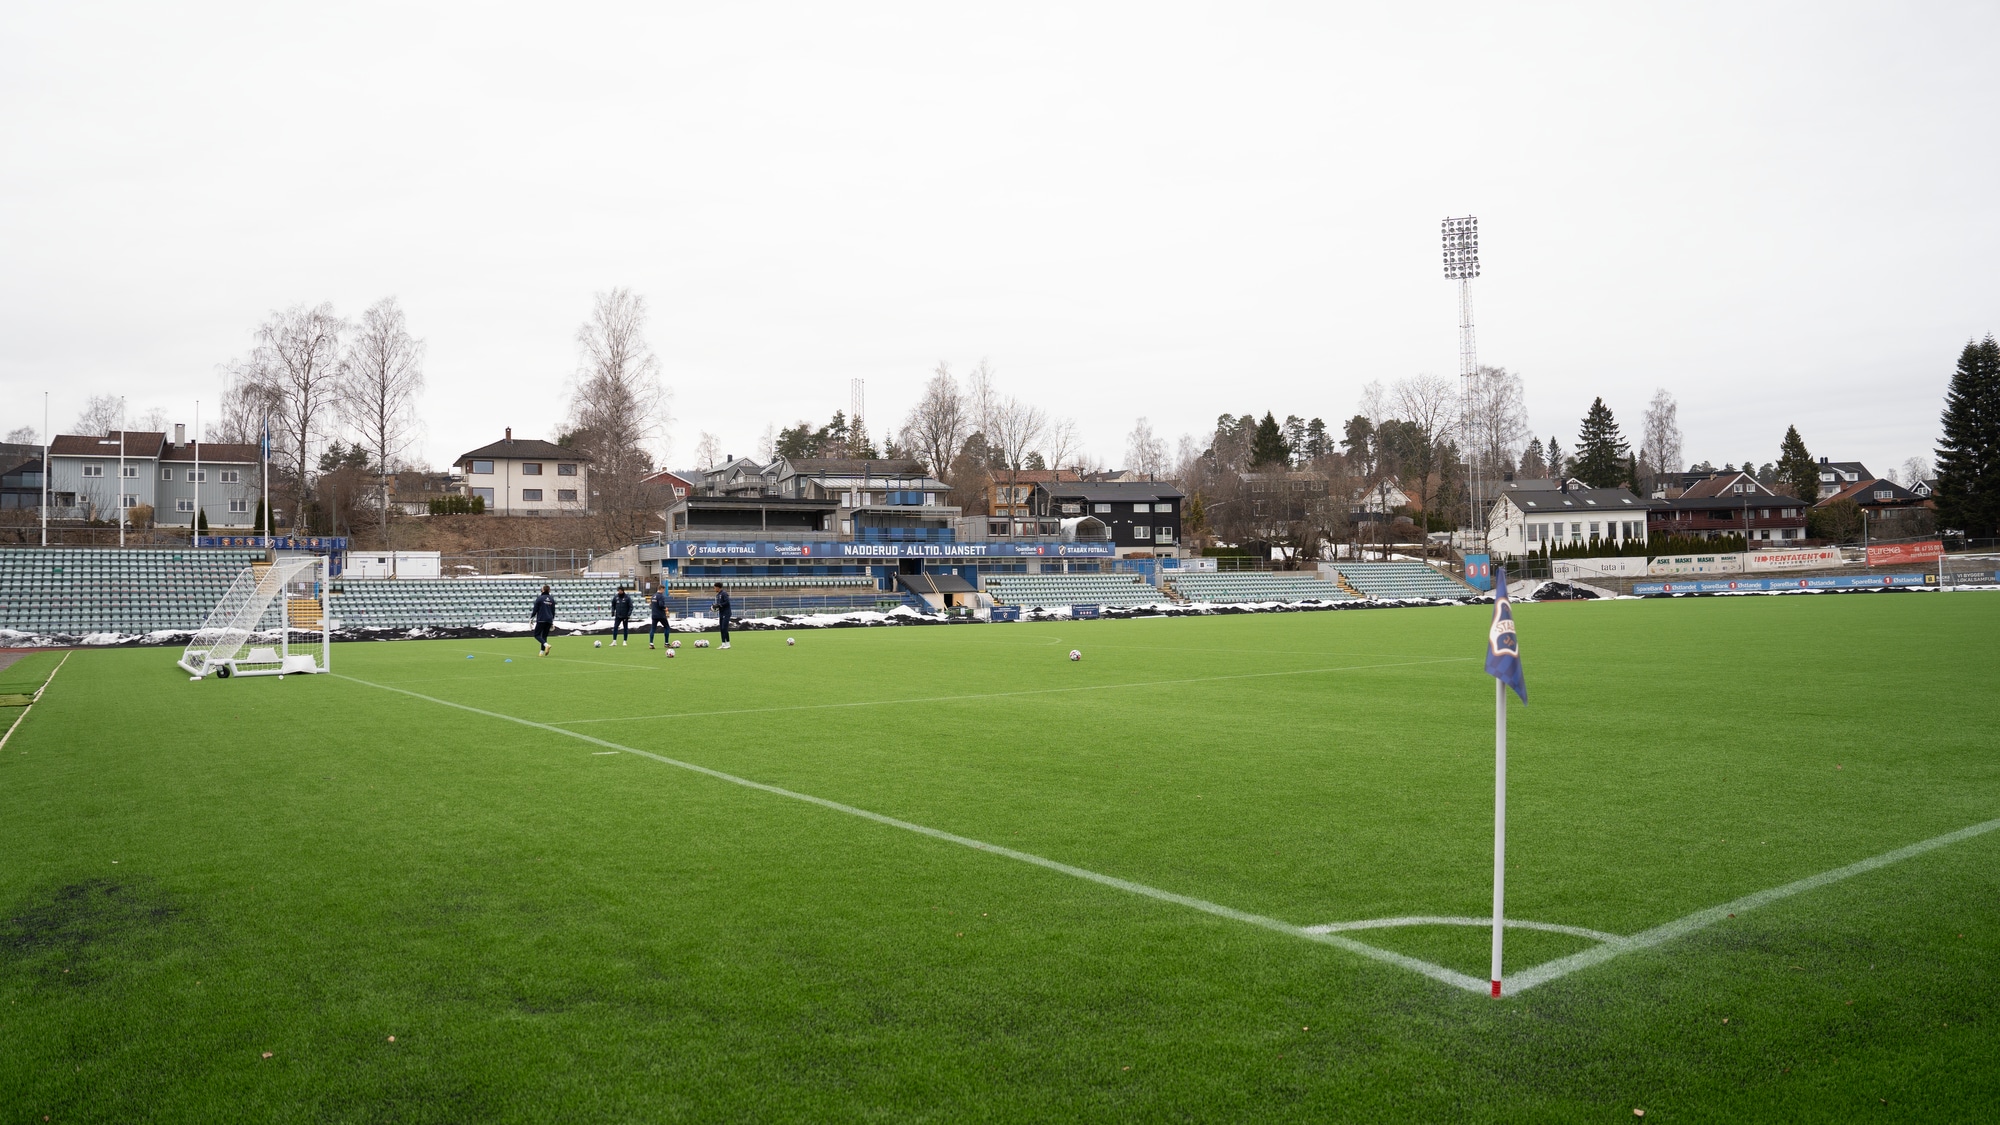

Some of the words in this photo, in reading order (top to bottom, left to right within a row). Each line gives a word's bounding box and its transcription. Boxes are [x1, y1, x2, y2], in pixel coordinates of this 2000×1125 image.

[699, 546, 726, 554] STABÆK
[727, 546, 756, 554] FOTBALL
[774, 545, 802, 553] SpareBank
[844, 545, 898, 556] NADDERUD
[906, 545, 943, 556] ALLTID.
[946, 545, 987, 556] UANSETT
[1867, 547, 1901, 556] eureka
[1769, 552, 1818, 562] RENTATENT
[1601, 562, 1617, 571] tata
[1808, 578, 1836, 586] Østlandet
[1851, 577, 1883, 586] SpareBank
